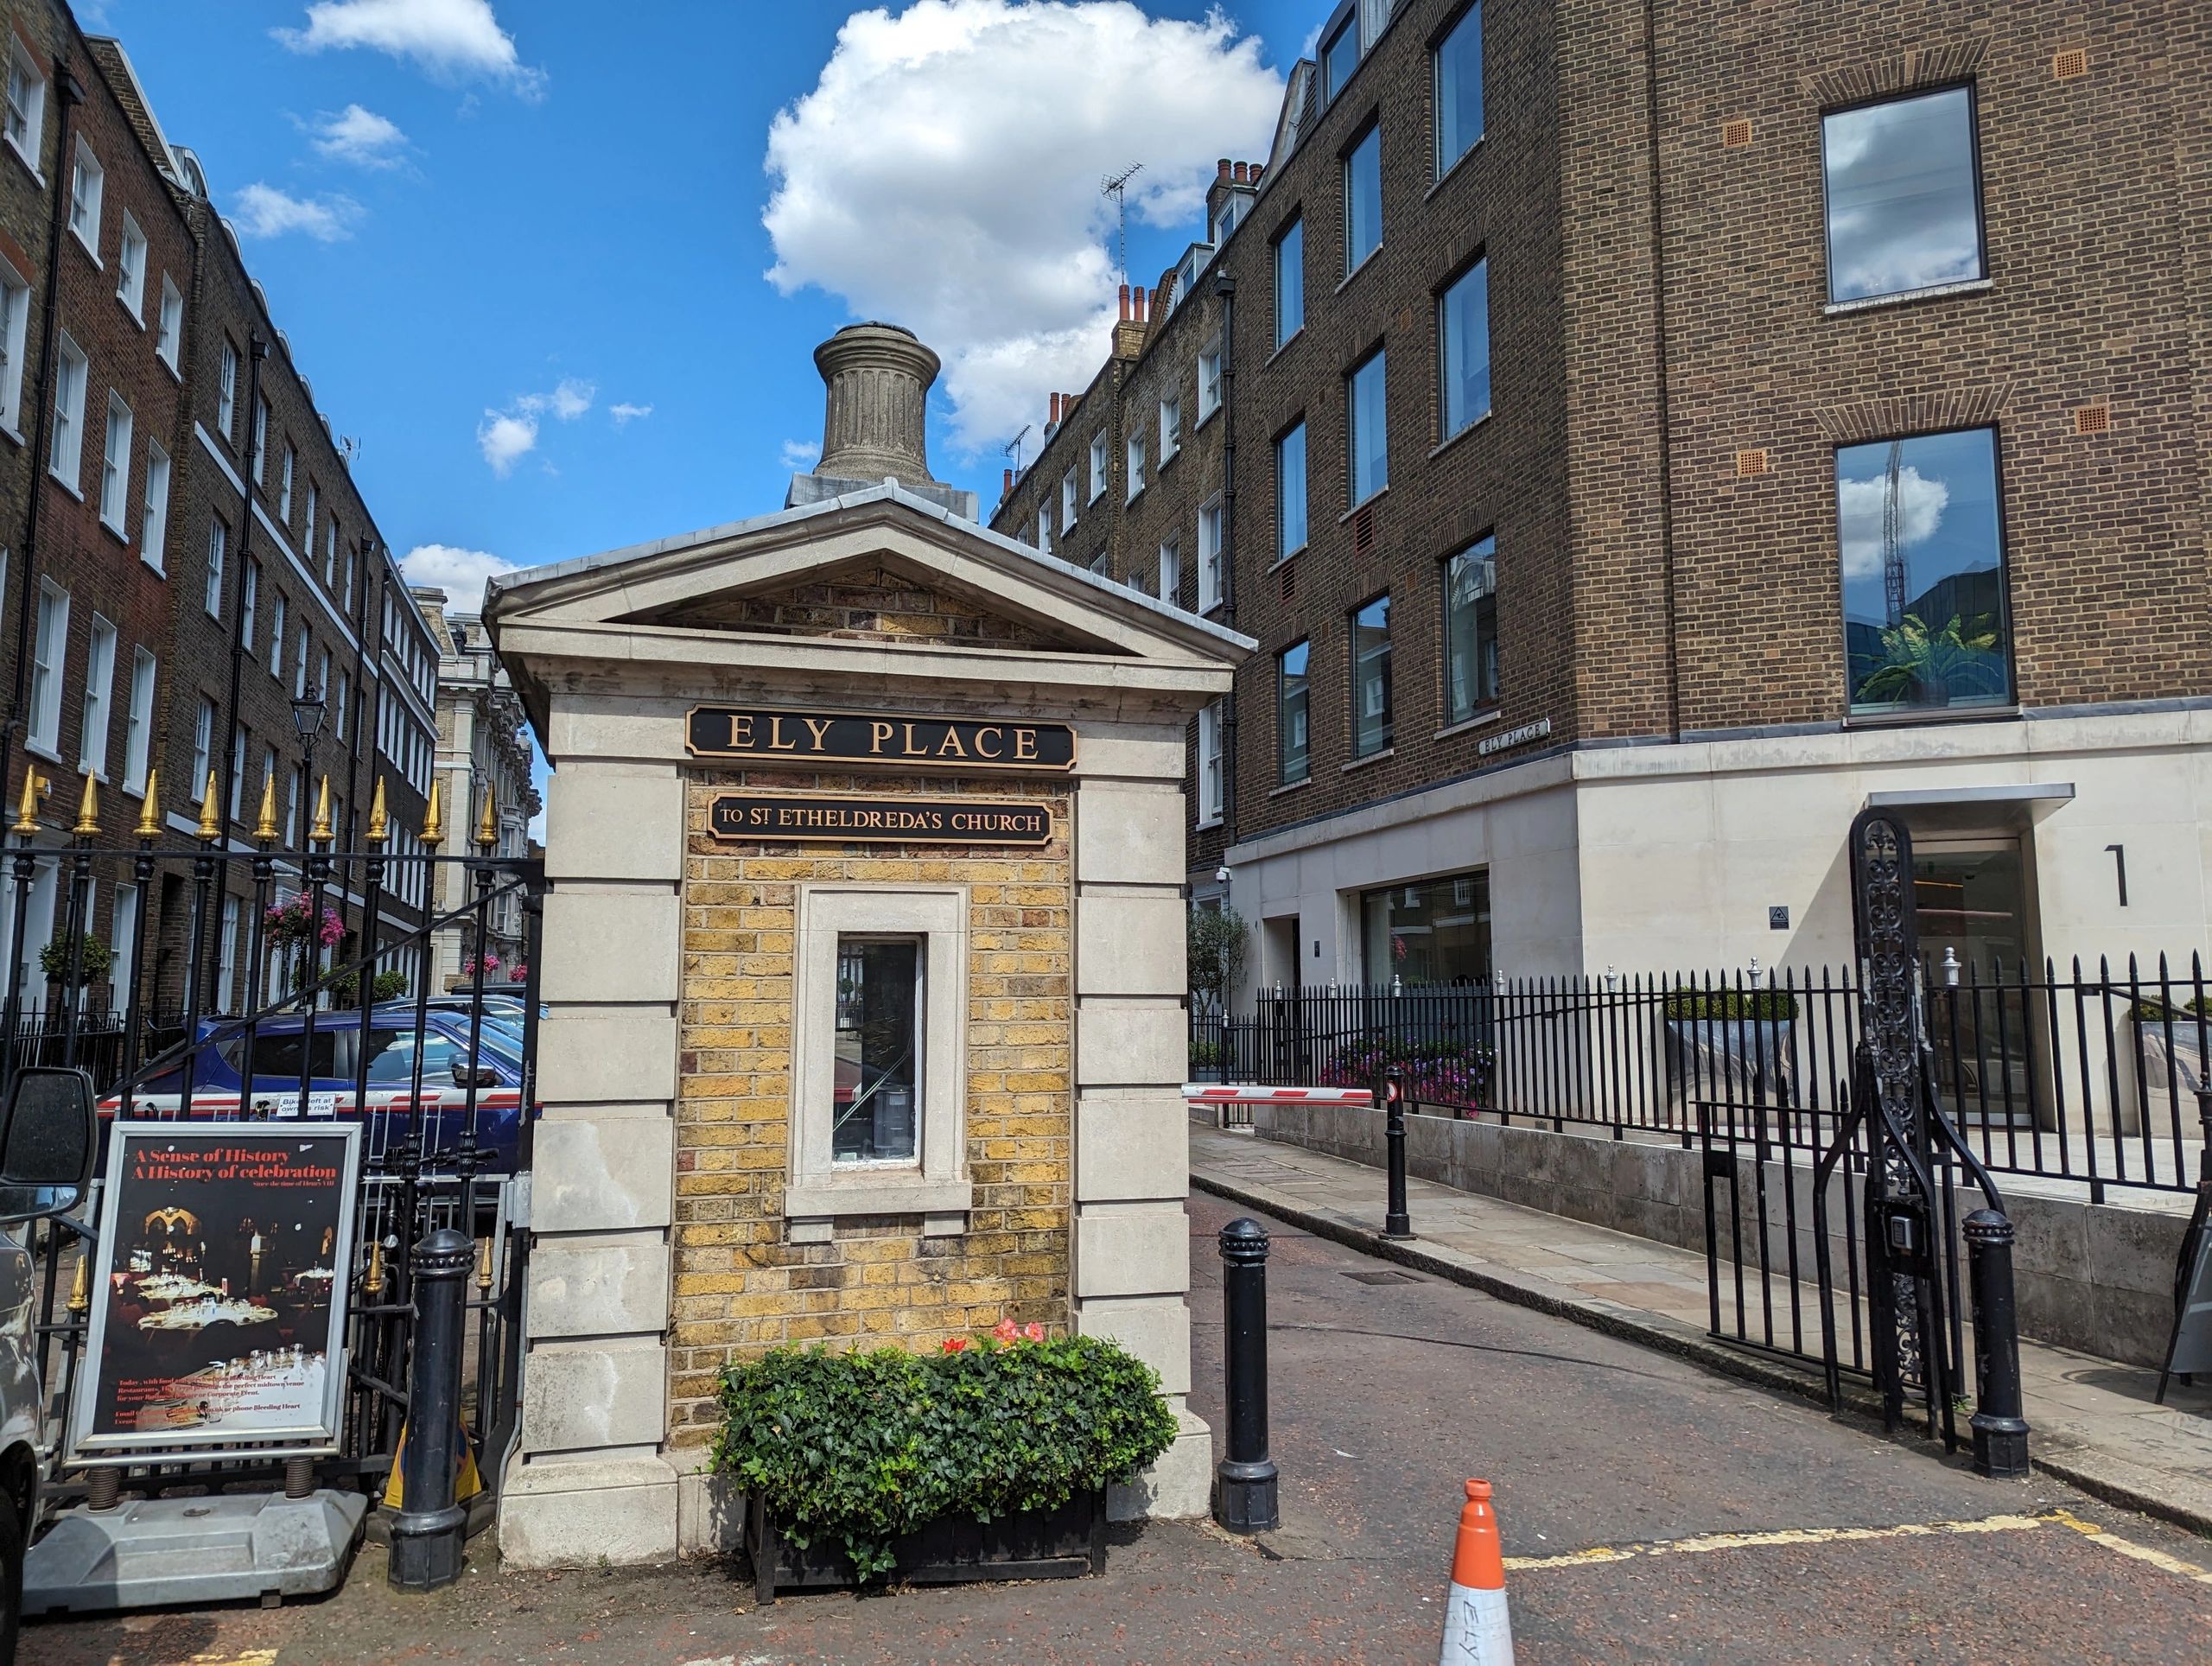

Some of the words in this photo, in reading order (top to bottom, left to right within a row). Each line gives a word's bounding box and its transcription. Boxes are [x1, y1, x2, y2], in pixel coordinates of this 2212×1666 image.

[727, 715, 836, 752] ELY
[868, 722, 1040, 760] PLACE
[1484, 735, 1503, 753] ELY
[1507, 724, 1541, 746] PLACE
[720, 808, 744, 823] TO
[778, 809, 943, 830] ETHELDREDA'S
[951, 814, 1042, 833] CHURCH
[2104, 844, 2128, 907] 1
[134, 1149, 146, 1162] A
[149, 1149, 200, 1162] Sense
[203, 1148, 225, 1162] of
[225, 1148, 290, 1166] History
[132, 1166, 144, 1180] A
[148, 1166, 214, 1182] History
[218, 1165, 238, 1179] of
[239, 1164, 337, 1180] celebration
[207, 1389, 240, 1398] Corporate
[233, 1382, 257, 1390] perfect
[1459, 1600, 1482, 1661] ELY
